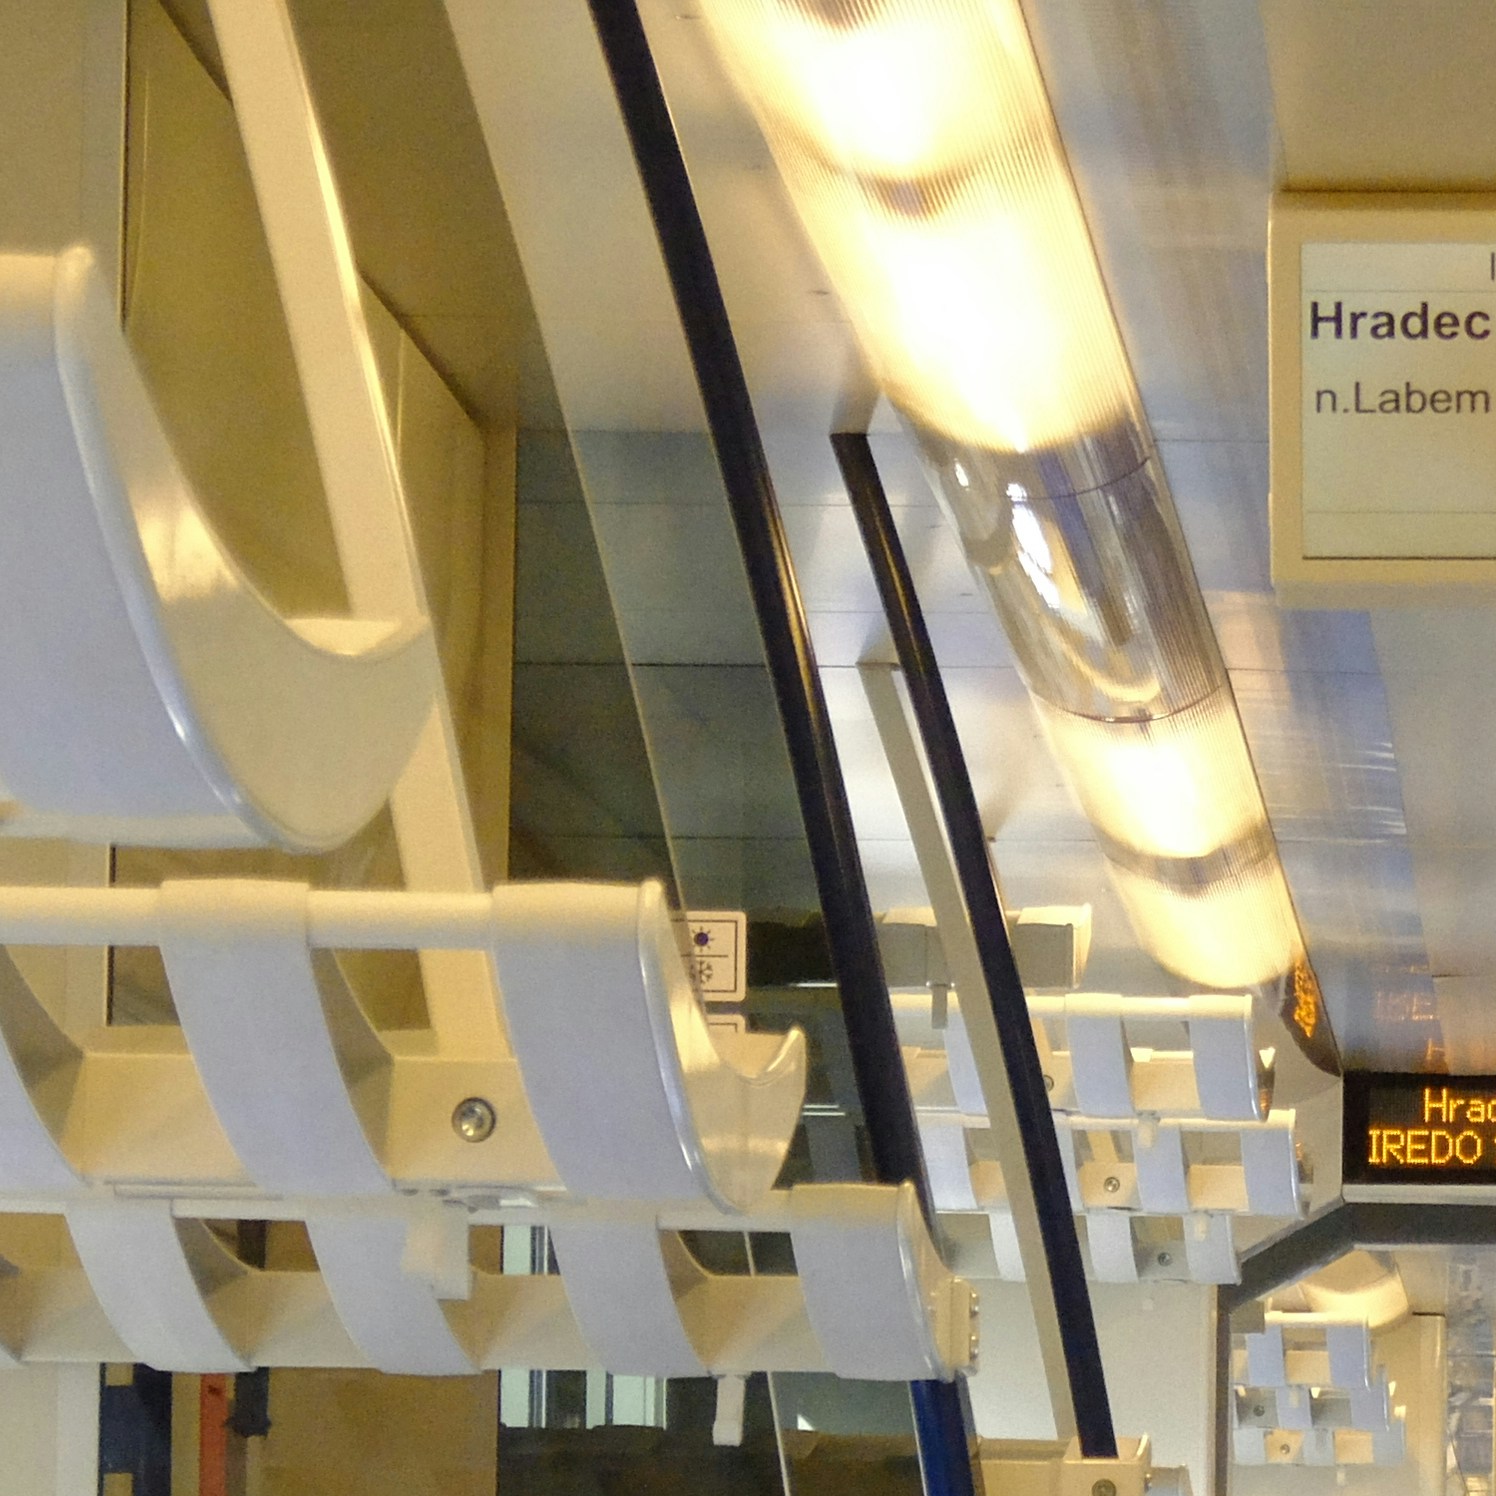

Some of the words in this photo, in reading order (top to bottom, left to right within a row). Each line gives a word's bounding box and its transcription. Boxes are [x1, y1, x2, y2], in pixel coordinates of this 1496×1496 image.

[1310, 301, 1491, 341] Hradec
[1314, 381, 1491, 415] n.Labem
[1368, 1128, 1483, 1166] IREDO
